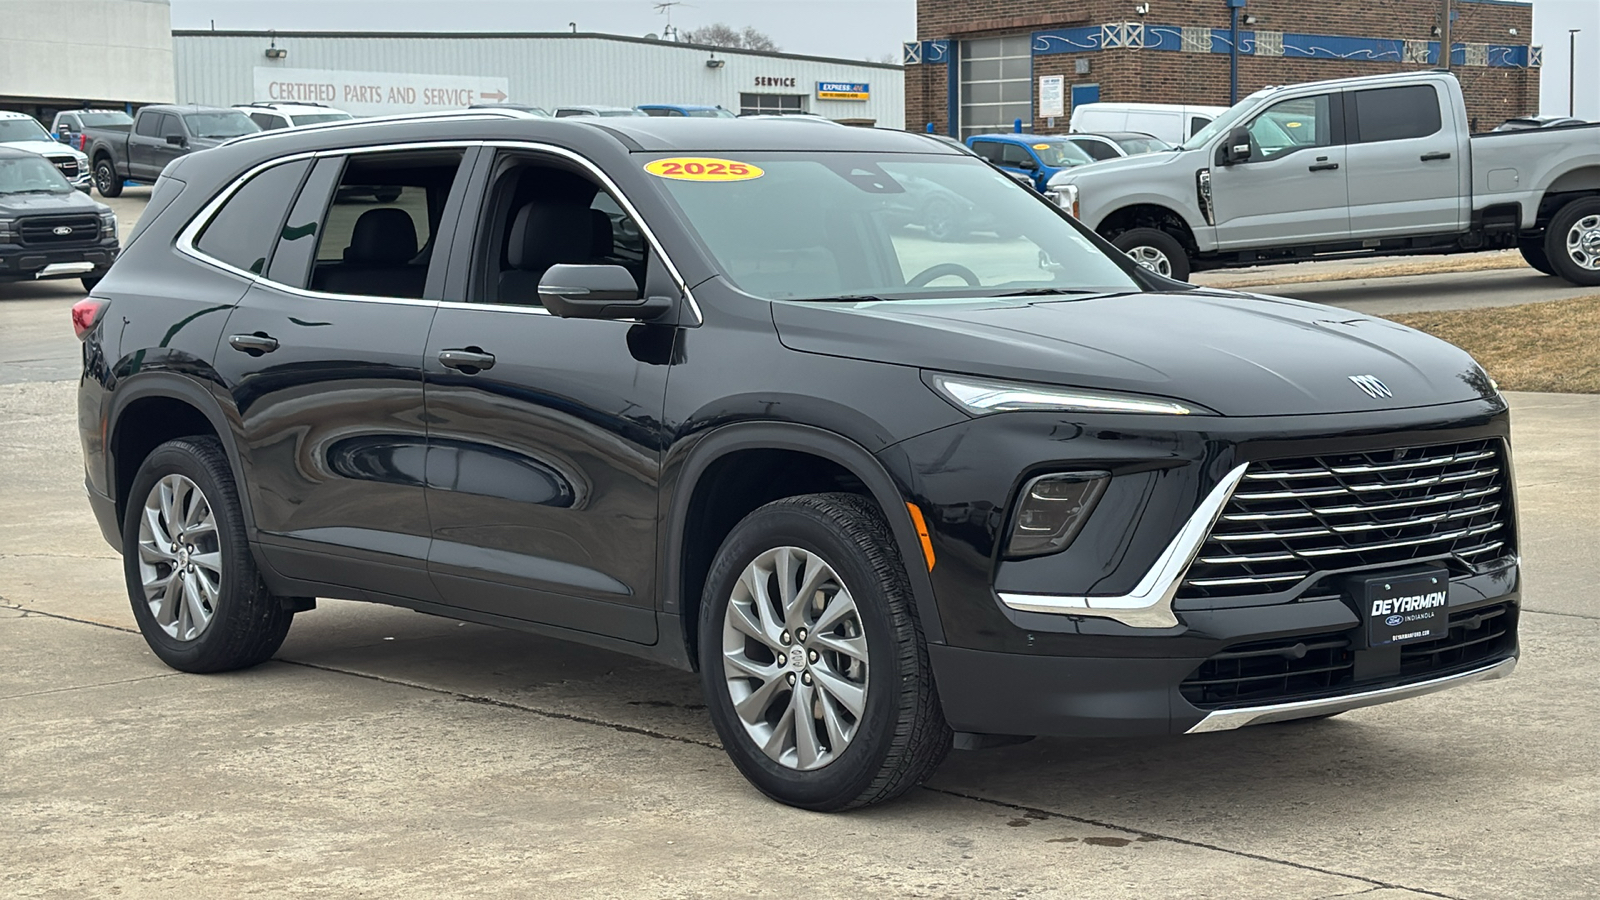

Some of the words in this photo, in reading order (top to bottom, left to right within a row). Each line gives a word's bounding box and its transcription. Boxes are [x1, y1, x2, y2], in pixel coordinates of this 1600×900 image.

[755, 76, 796, 87] SERVICE
[822, 83, 851, 92] EXPRESS
[269, 82, 336, 102] CERTIFIED
[344, 85, 382, 103] PARTS
[387, 87, 416, 105] AND
[423, 88, 474, 106] SERVICE
[662, 162, 749, 175] 2025
[1371, 591, 1447, 616] DEYARMAN
[1404, 612, 1435, 622] INDIANOLA
